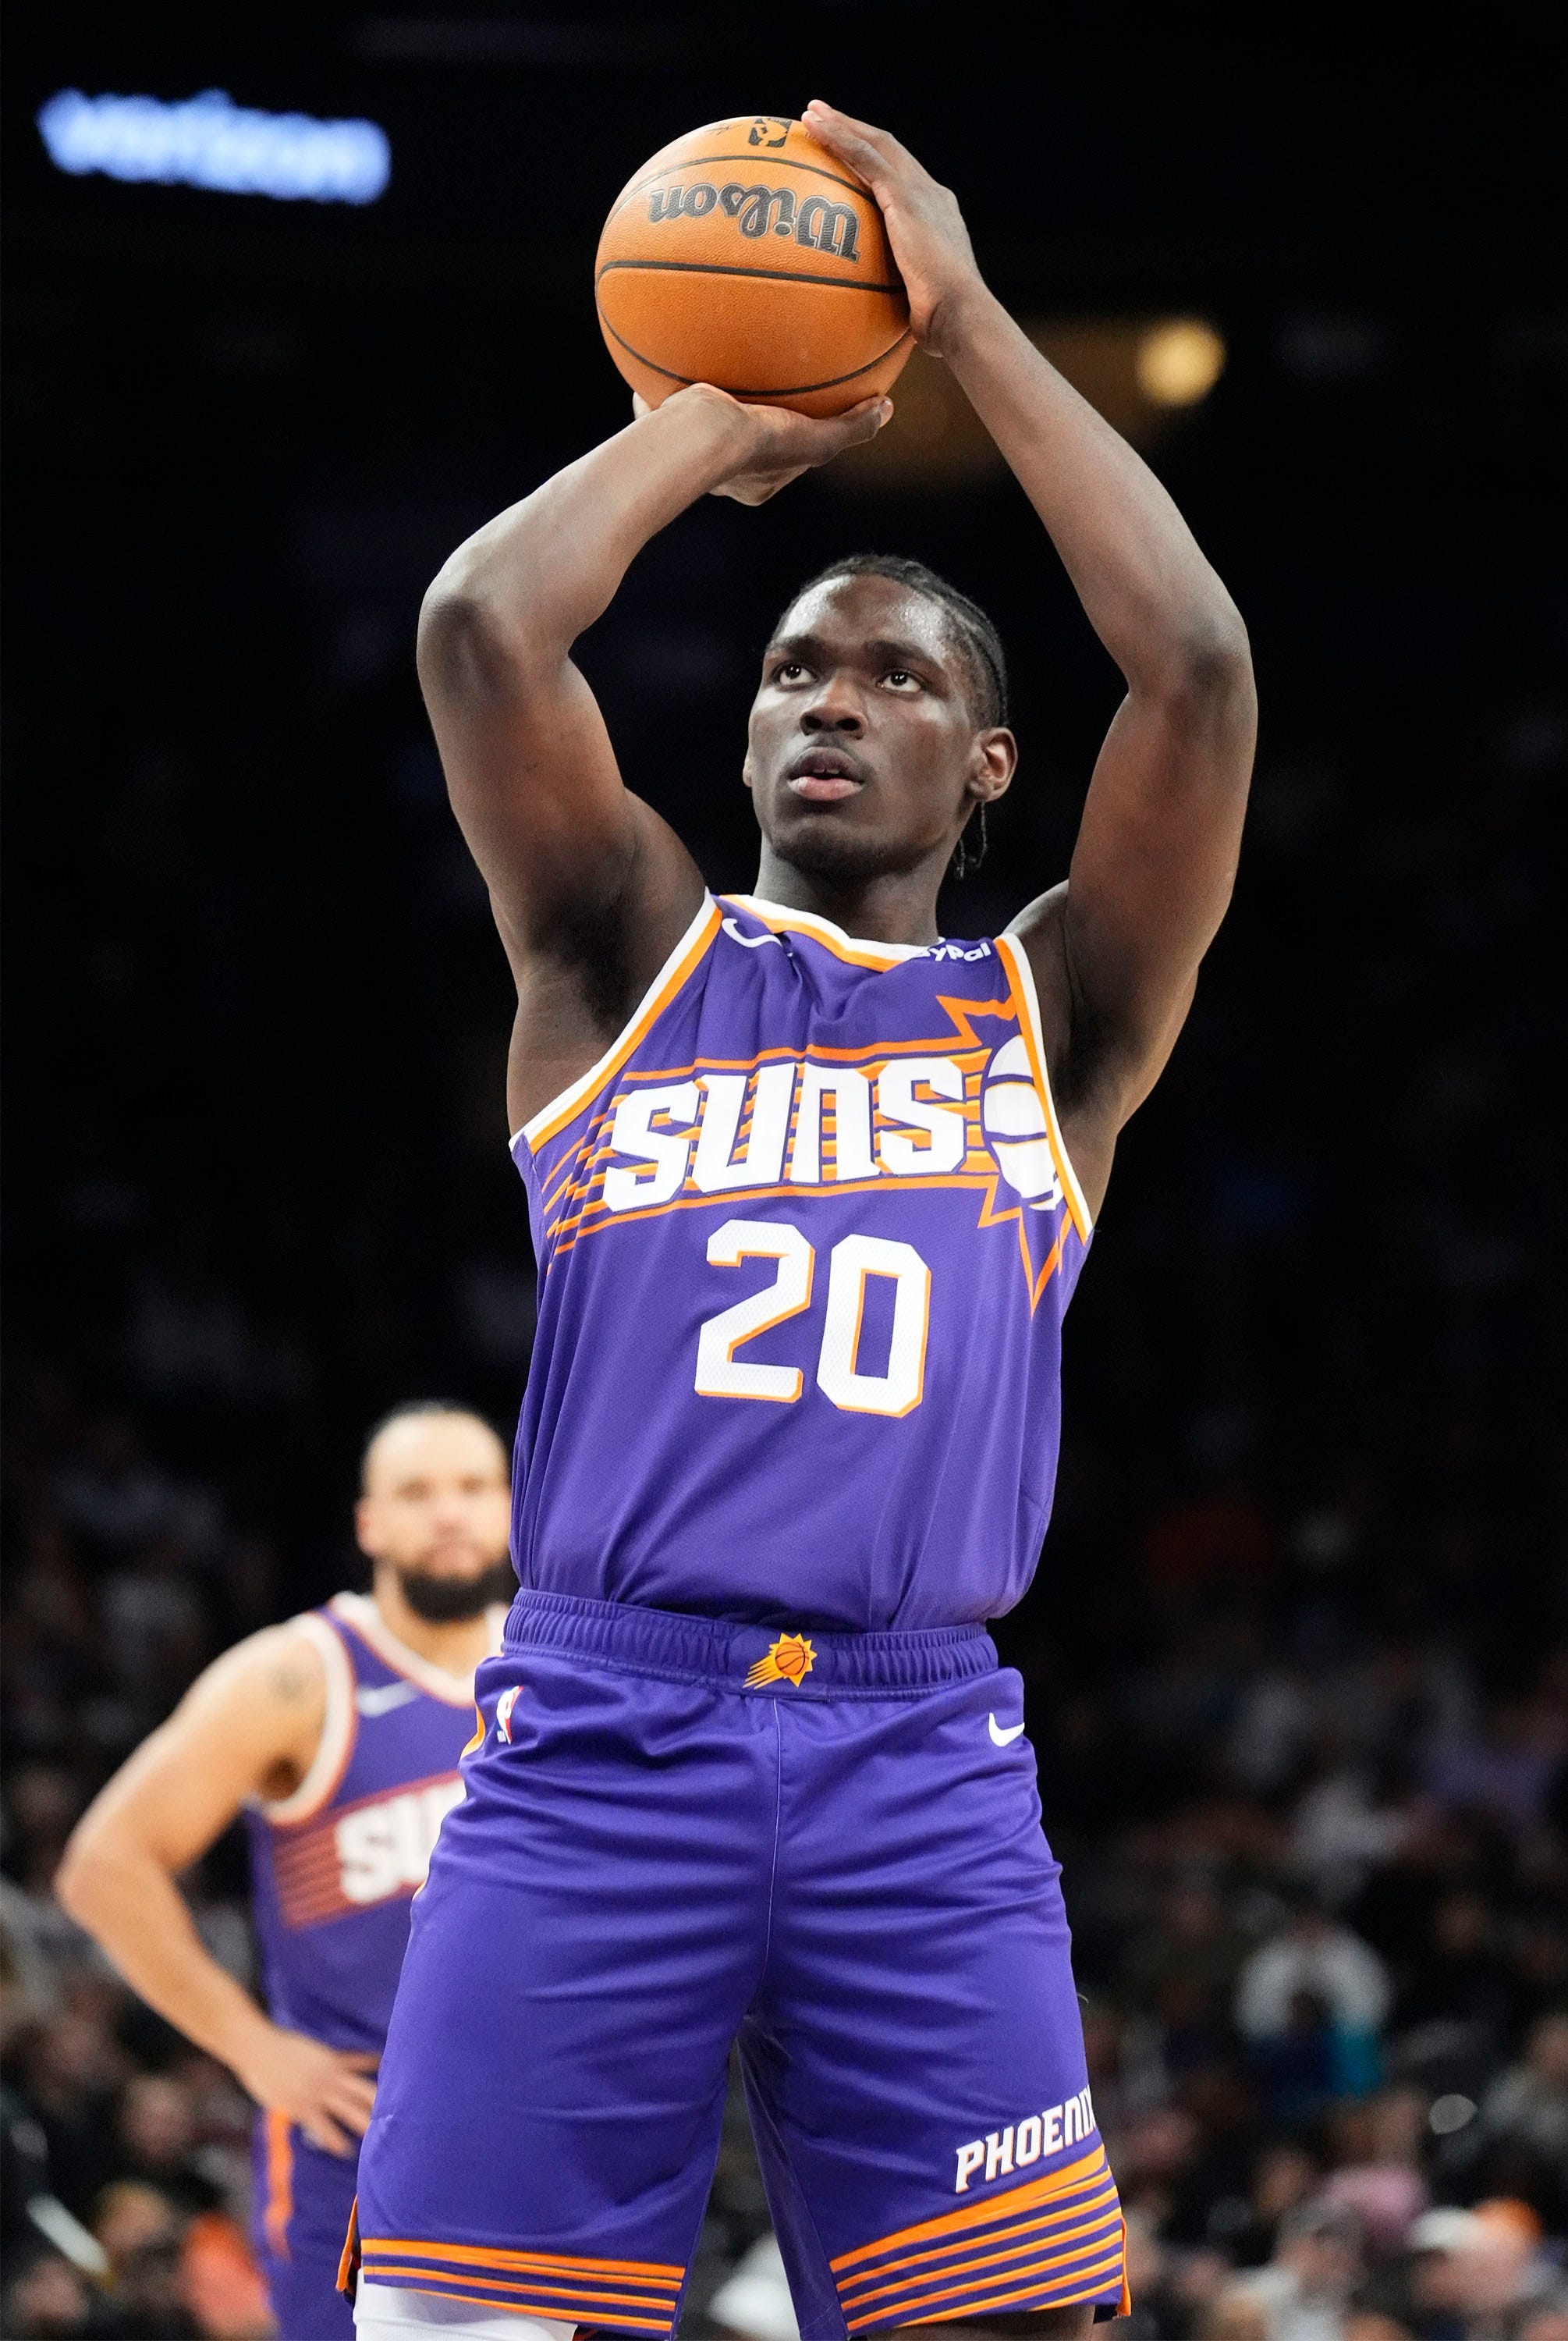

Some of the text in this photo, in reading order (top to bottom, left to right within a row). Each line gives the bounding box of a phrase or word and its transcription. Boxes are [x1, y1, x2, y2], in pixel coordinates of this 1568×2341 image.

[649, 183, 859, 262] Wilson
[602, 1057, 966, 1212] SUNS
[694, 1219, 931, 1418] 20
